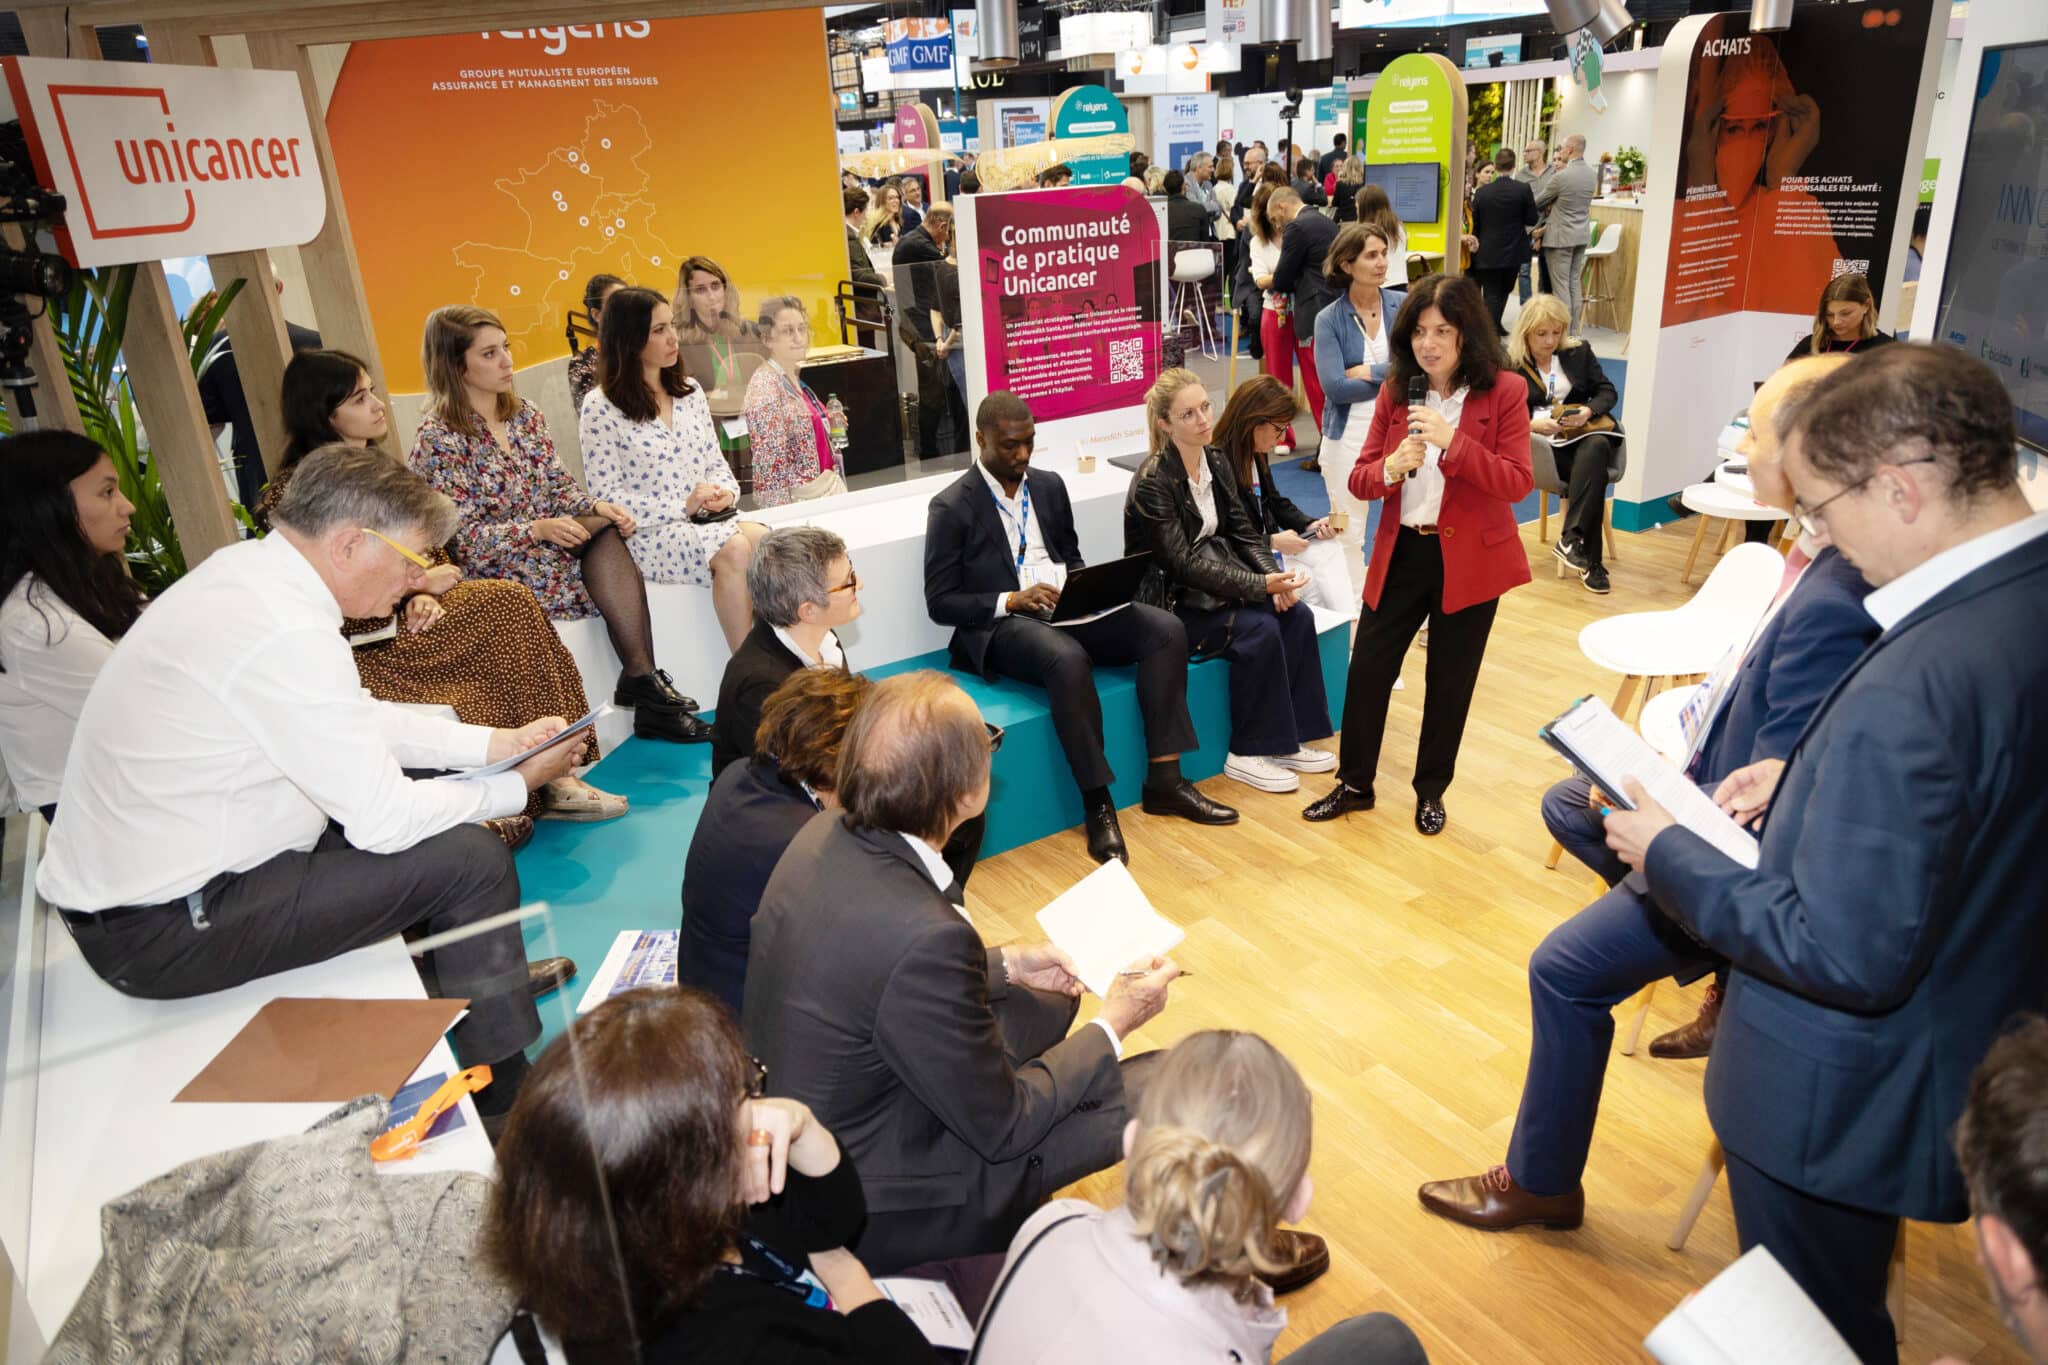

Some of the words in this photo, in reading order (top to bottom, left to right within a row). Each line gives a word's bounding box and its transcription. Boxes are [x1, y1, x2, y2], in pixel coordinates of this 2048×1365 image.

[1702, 37, 1751, 57] ACHATS
[889, 47, 908, 66] GMF
[912, 45, 949, 64] GMF
[460, 69, 504, 78] GROUPE
[509, 68, 572, 77] MUTUALISTE
[577, 66, 630, 76] EUROPÉEN
[432, 81, 498, 90] ASSURANCE
[502, 80, 513, 88] ET
[518, 78, 589, 88] MANAGEMENT
[594, 77, 612, 87] DES
[617, 76, 658, 86] RISQUES
[1083, 102, 1108, 113] relyens
[1180, 104, 1199, 117] FHF
[114, 122, 300, 184] unicancer
[1782, 176, 1803, 184] POUR
[1805, 176, 1819, 184] DES
[1821, 176, 1853, 184] ACHATS
[1001, 213, 1130, 246] Communauté
[1003, 249, 1027, 271] de
[1035, 242, 1119, 272] pratique
[1004, 271, 1097, 296] Unicancer
[1015, 319, 1043, 328] partenariat
[1063, 324, 1073, 332] pour
[1033, 336, 1051, 344] grande
[1067, 349, 1085, 357] partage
[1028, 363, 1052, 373] pratiques
[1010, 377, 1021, 385] pour
[1017, 383, 1031, 391] santé
